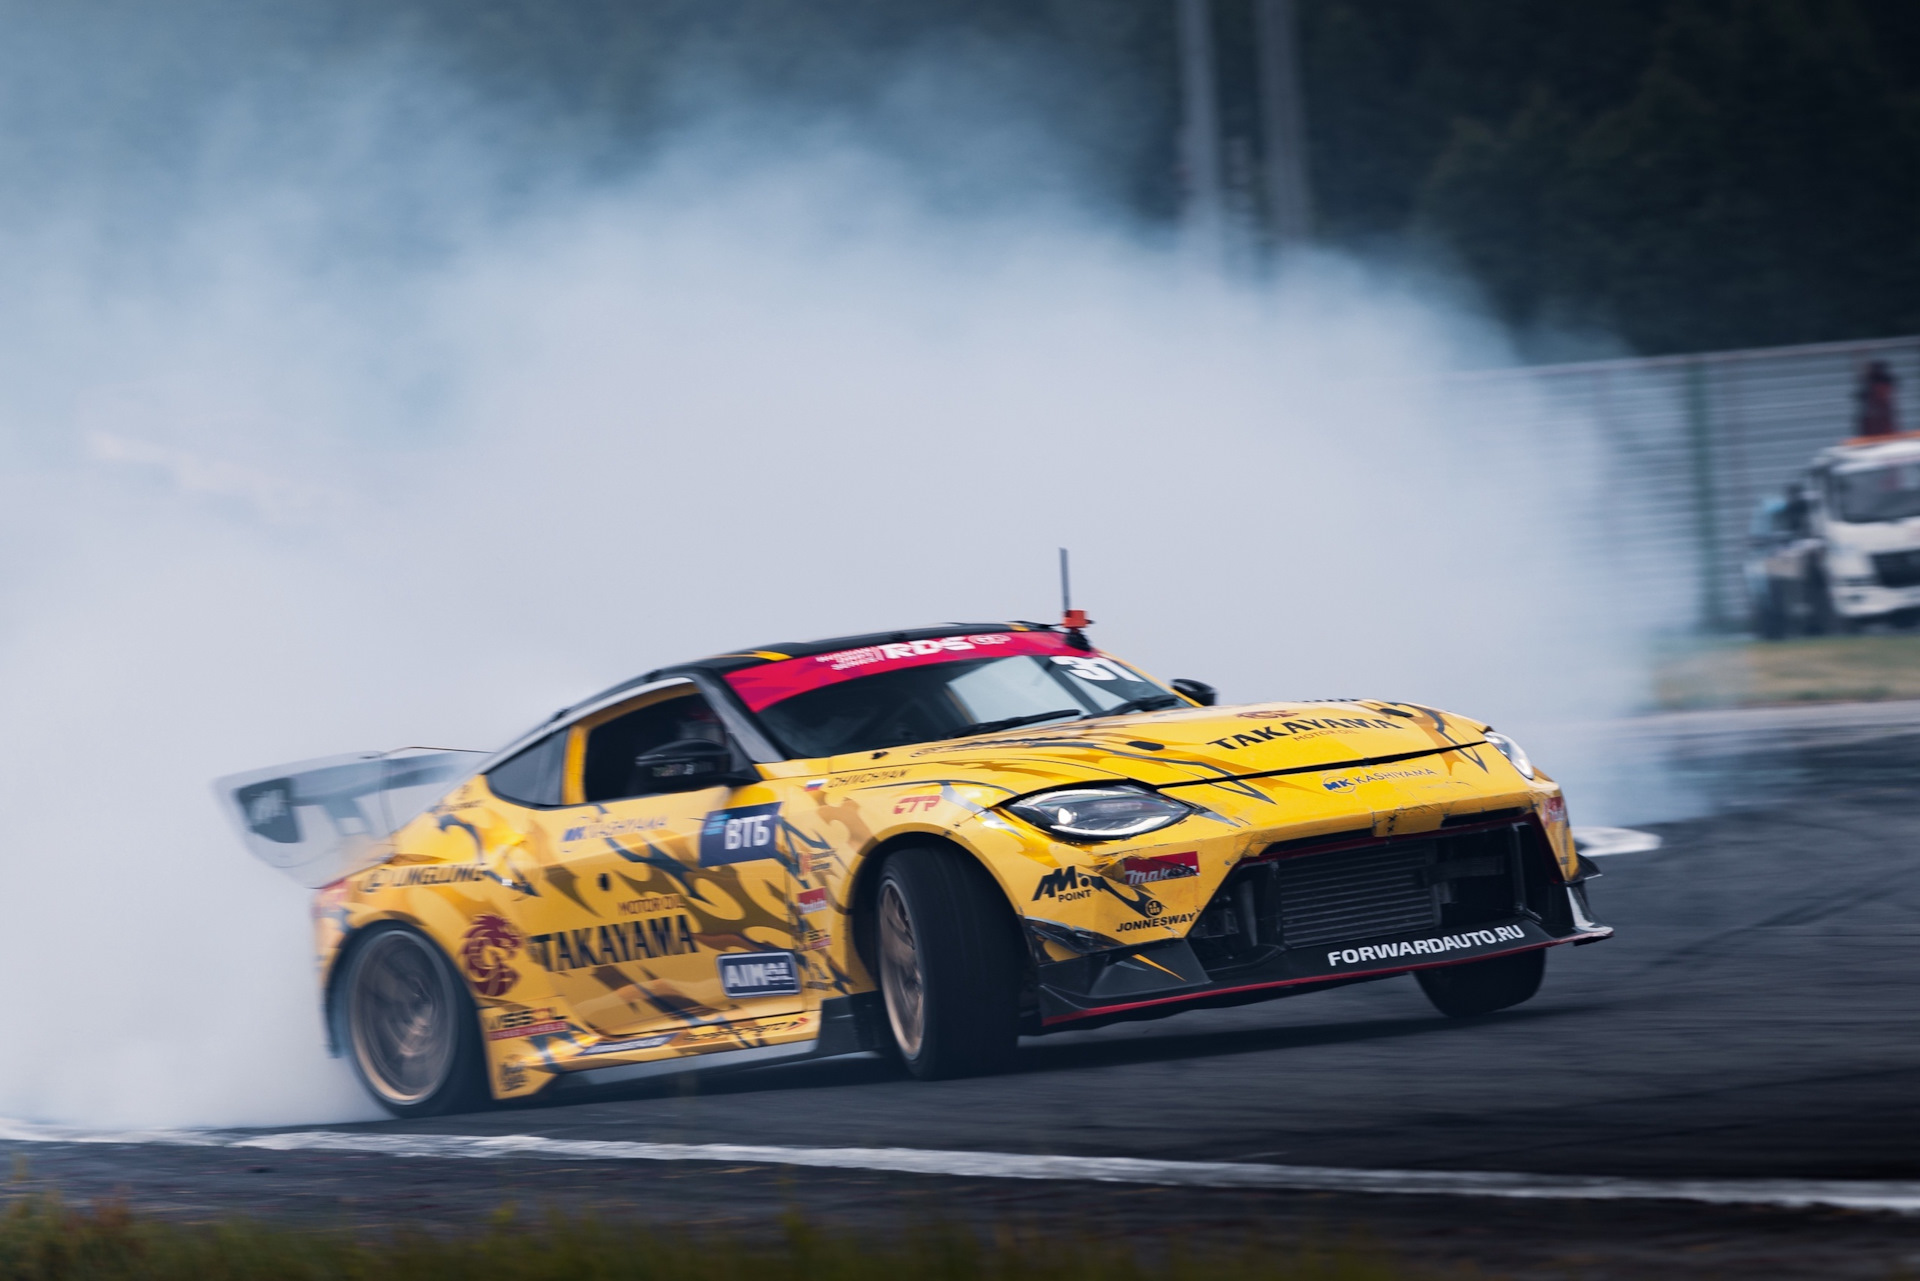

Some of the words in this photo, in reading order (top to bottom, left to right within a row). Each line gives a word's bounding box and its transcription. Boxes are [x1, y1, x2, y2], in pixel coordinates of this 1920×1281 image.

[879, 636, 976, 659] RDS
[1205, 718, 1403, 750] TAKAYAMA
[1294, 729, 1335, 742] MOTOR
[1337, 728, 1360, 737] OIL
[1322, 778, 1355, 791] MK
[1353, 768, 1438, 784] KASHIYAMA
[1058, 889, 1092, 903] POINT
[1115, 911, 1196, 933] JONNESWAY
[526, 914, 701, 973] TAKAYAMA
[1326, 924, 1526, 967] FORWARDAUTO.RU
